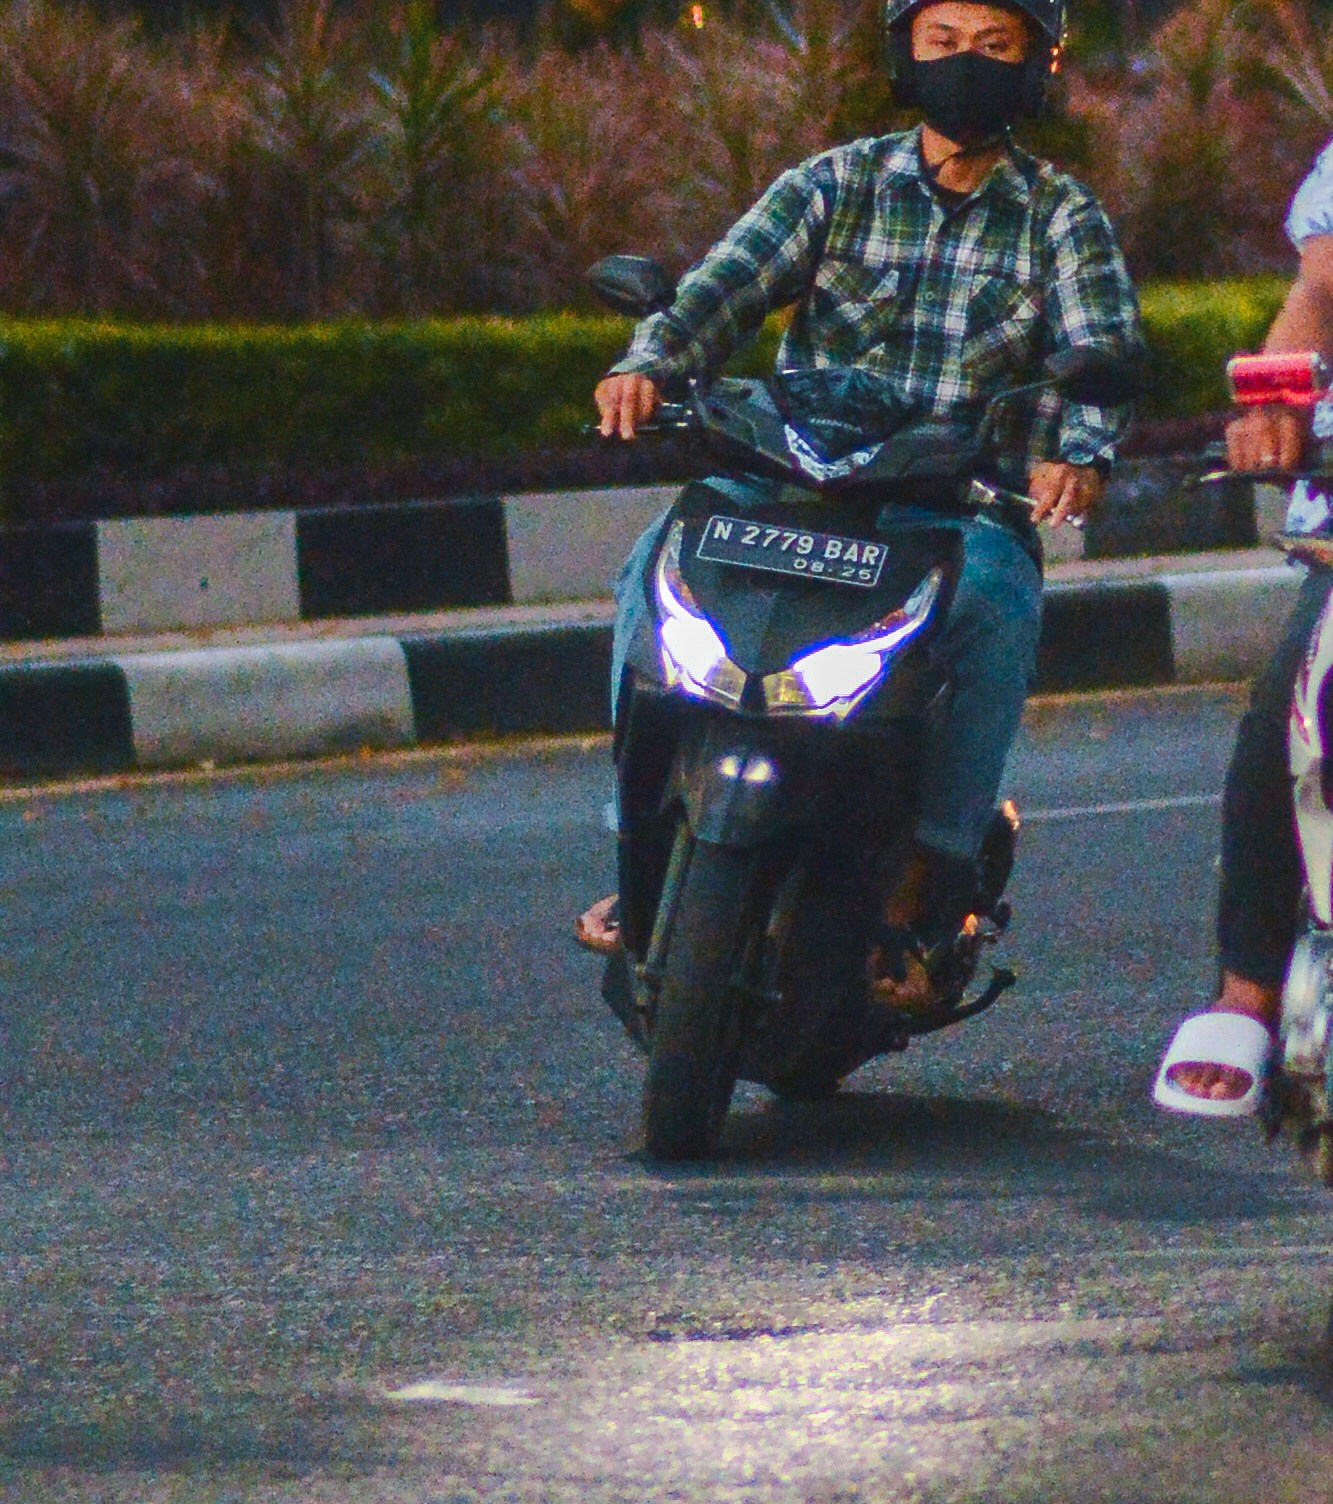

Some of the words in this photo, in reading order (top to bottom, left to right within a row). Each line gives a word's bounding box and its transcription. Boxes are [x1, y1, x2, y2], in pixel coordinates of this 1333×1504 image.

[713, 520, 733, 541] N
[740, 525, 815, 555] 2779
[823, 539, 880, 566] BAR
